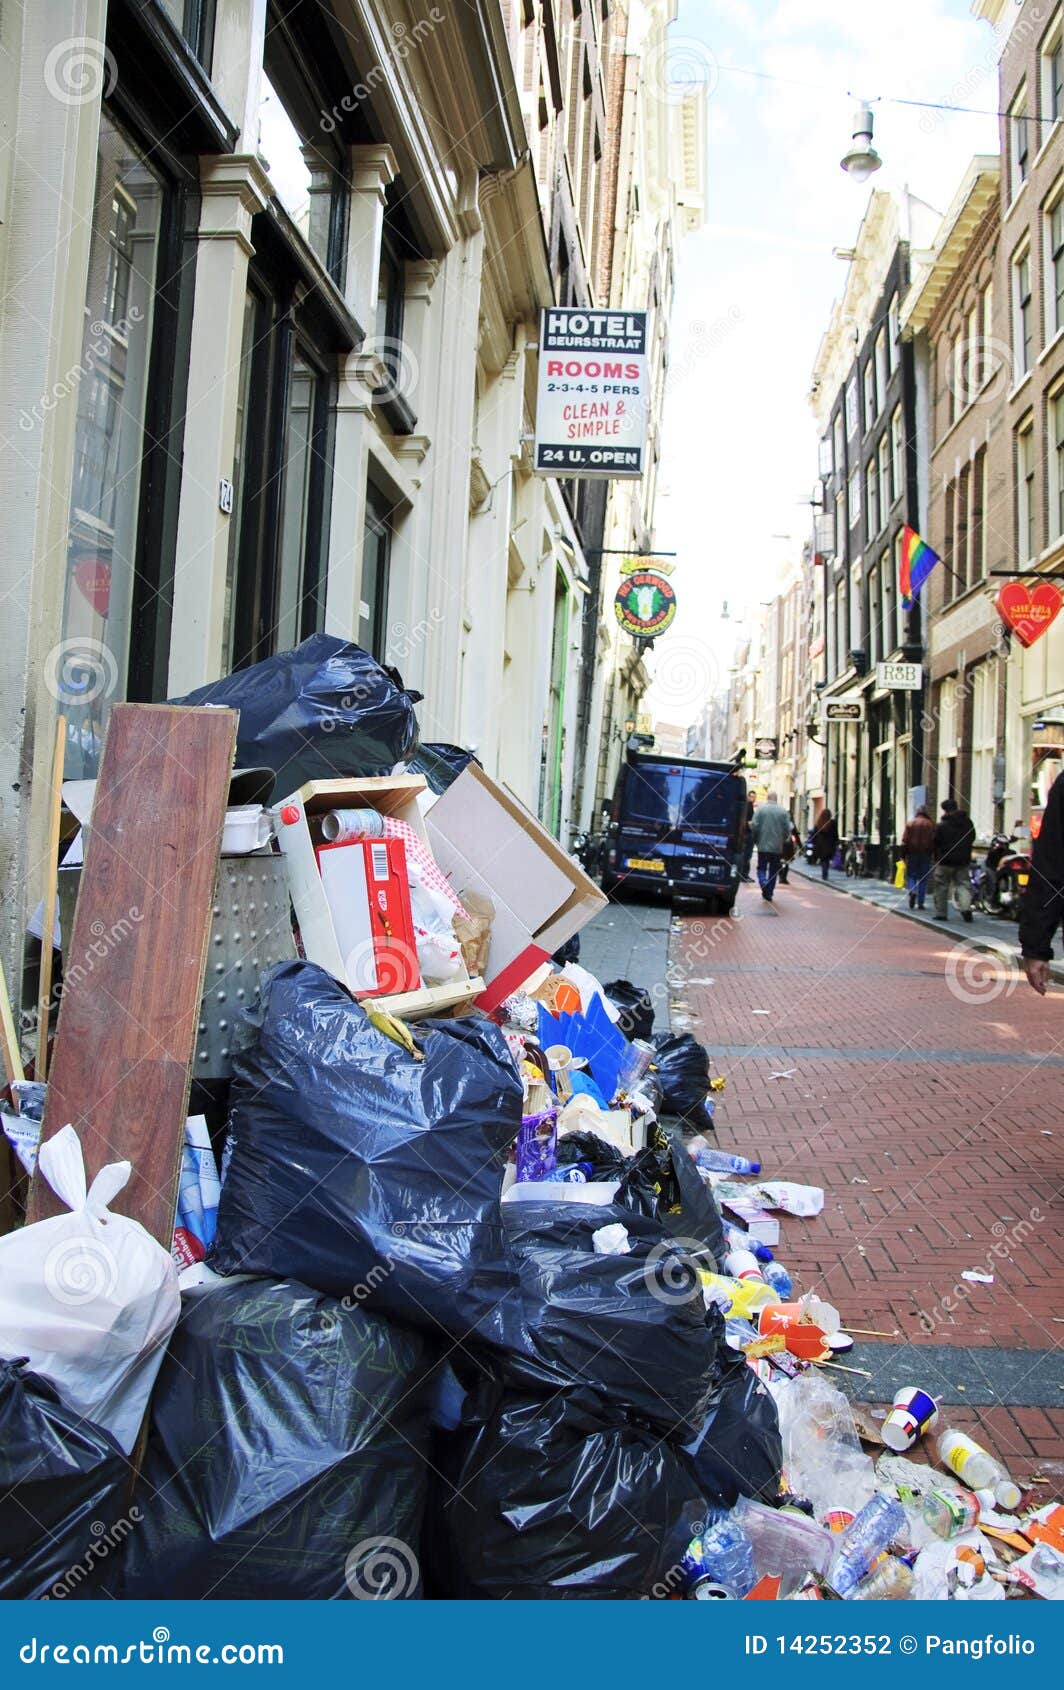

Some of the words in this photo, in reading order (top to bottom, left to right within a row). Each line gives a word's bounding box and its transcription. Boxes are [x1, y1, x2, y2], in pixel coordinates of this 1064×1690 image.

[549, 314, 642, 337] HOTEL
[548, 336, 641, 349] BEURSSTRAAT
[547, 361, 640, 379] ROOMS
[547, 383, 598, 394] 2-3-4-5
[603, 385, 640, 395] PERS
[563, 402, 609, 420] CLEAN
[615, 400, 626, 415] &
[567, 420, 620, 439] SIMPLE
[543, 450, 564, 462] 24
[569, 451, 586, 463] U.
[590, 451, 638, 465] OPEN
